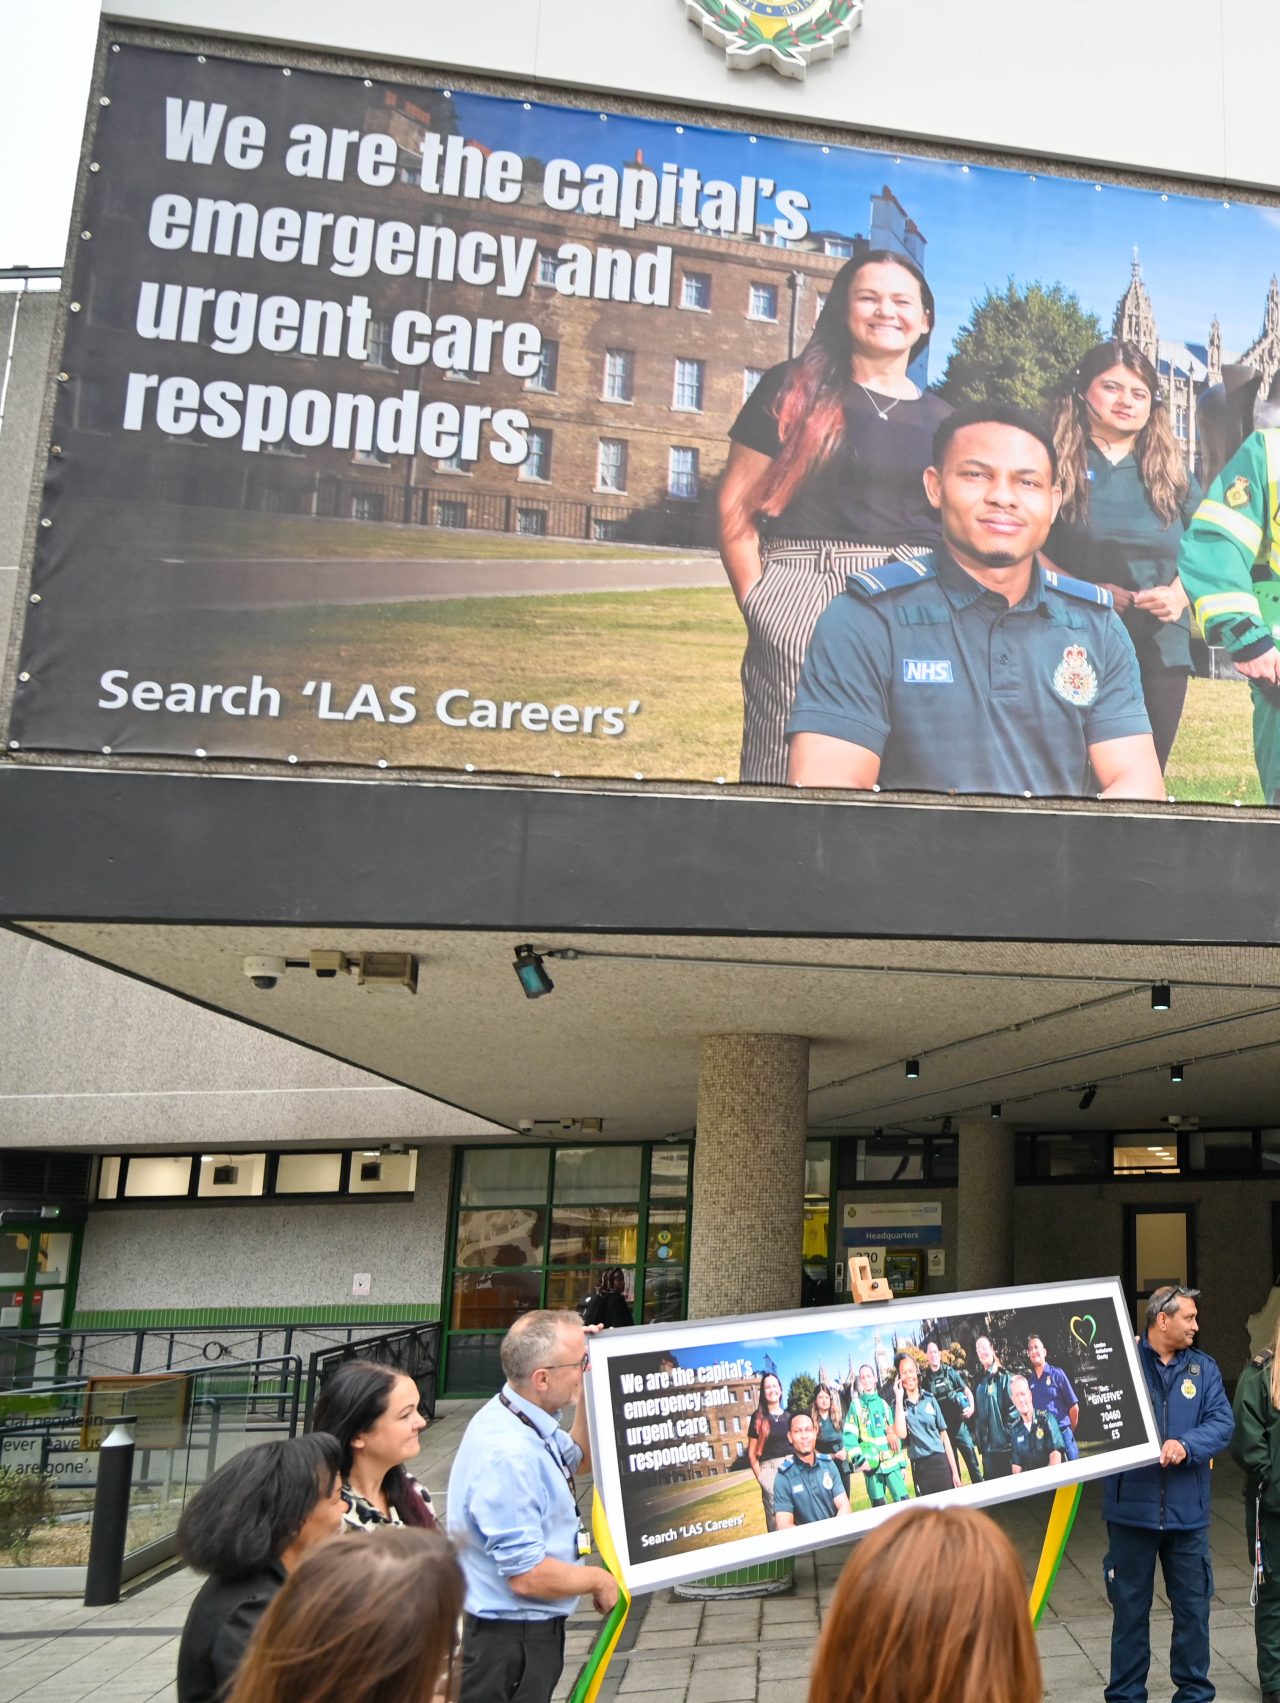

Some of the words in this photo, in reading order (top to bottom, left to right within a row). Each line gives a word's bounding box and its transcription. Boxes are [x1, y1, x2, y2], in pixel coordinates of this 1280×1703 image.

[165, 96, 266, 170] We
[285, 123, 398, 187] are
[420, 131, 523, 204] the
[543, 158, 811, 241] capital's
[149, 193, 537, 298] emergency
[555, 243, 672, 307] and
[136, 281, 371, 360] urgent
[391, 309, 542, 378] care
[123, 372, 530, 465] responders
[907, 662, 948, 680] NHS
[98, 669, 281, 718] Search
[302, 681, 417, 725] 'LAS
[435, 688, 641, 736] Careers'
[865, 1232, 919, 1240] Headquarters
[621, 1373, 643, 1394] We
[646, 1372, 670, 1391] are
[672, 1367, 695, 1387] the
[697, 1359, 753, 1384] capital's
[623, 1391, 702, 1420] emergency
[705, 1385, 729, 1407] and
[1100, 1409, 1121, 1422] 70460
[2, 1440, 37, 1452] ever
[626, 1419, 674, 1446] urgent
[676, 1416, 708, 1437] care
[1112, 1429, 1120, 1440] £5
[16, 1463, 41, 1475] are
[629, 1441, 710, 1472] responders
[641, 1529, 677, 1547] Search
[680, 1523, 703, 1537] 'LAS
[705, 1513, 745, 1532] Careers'
